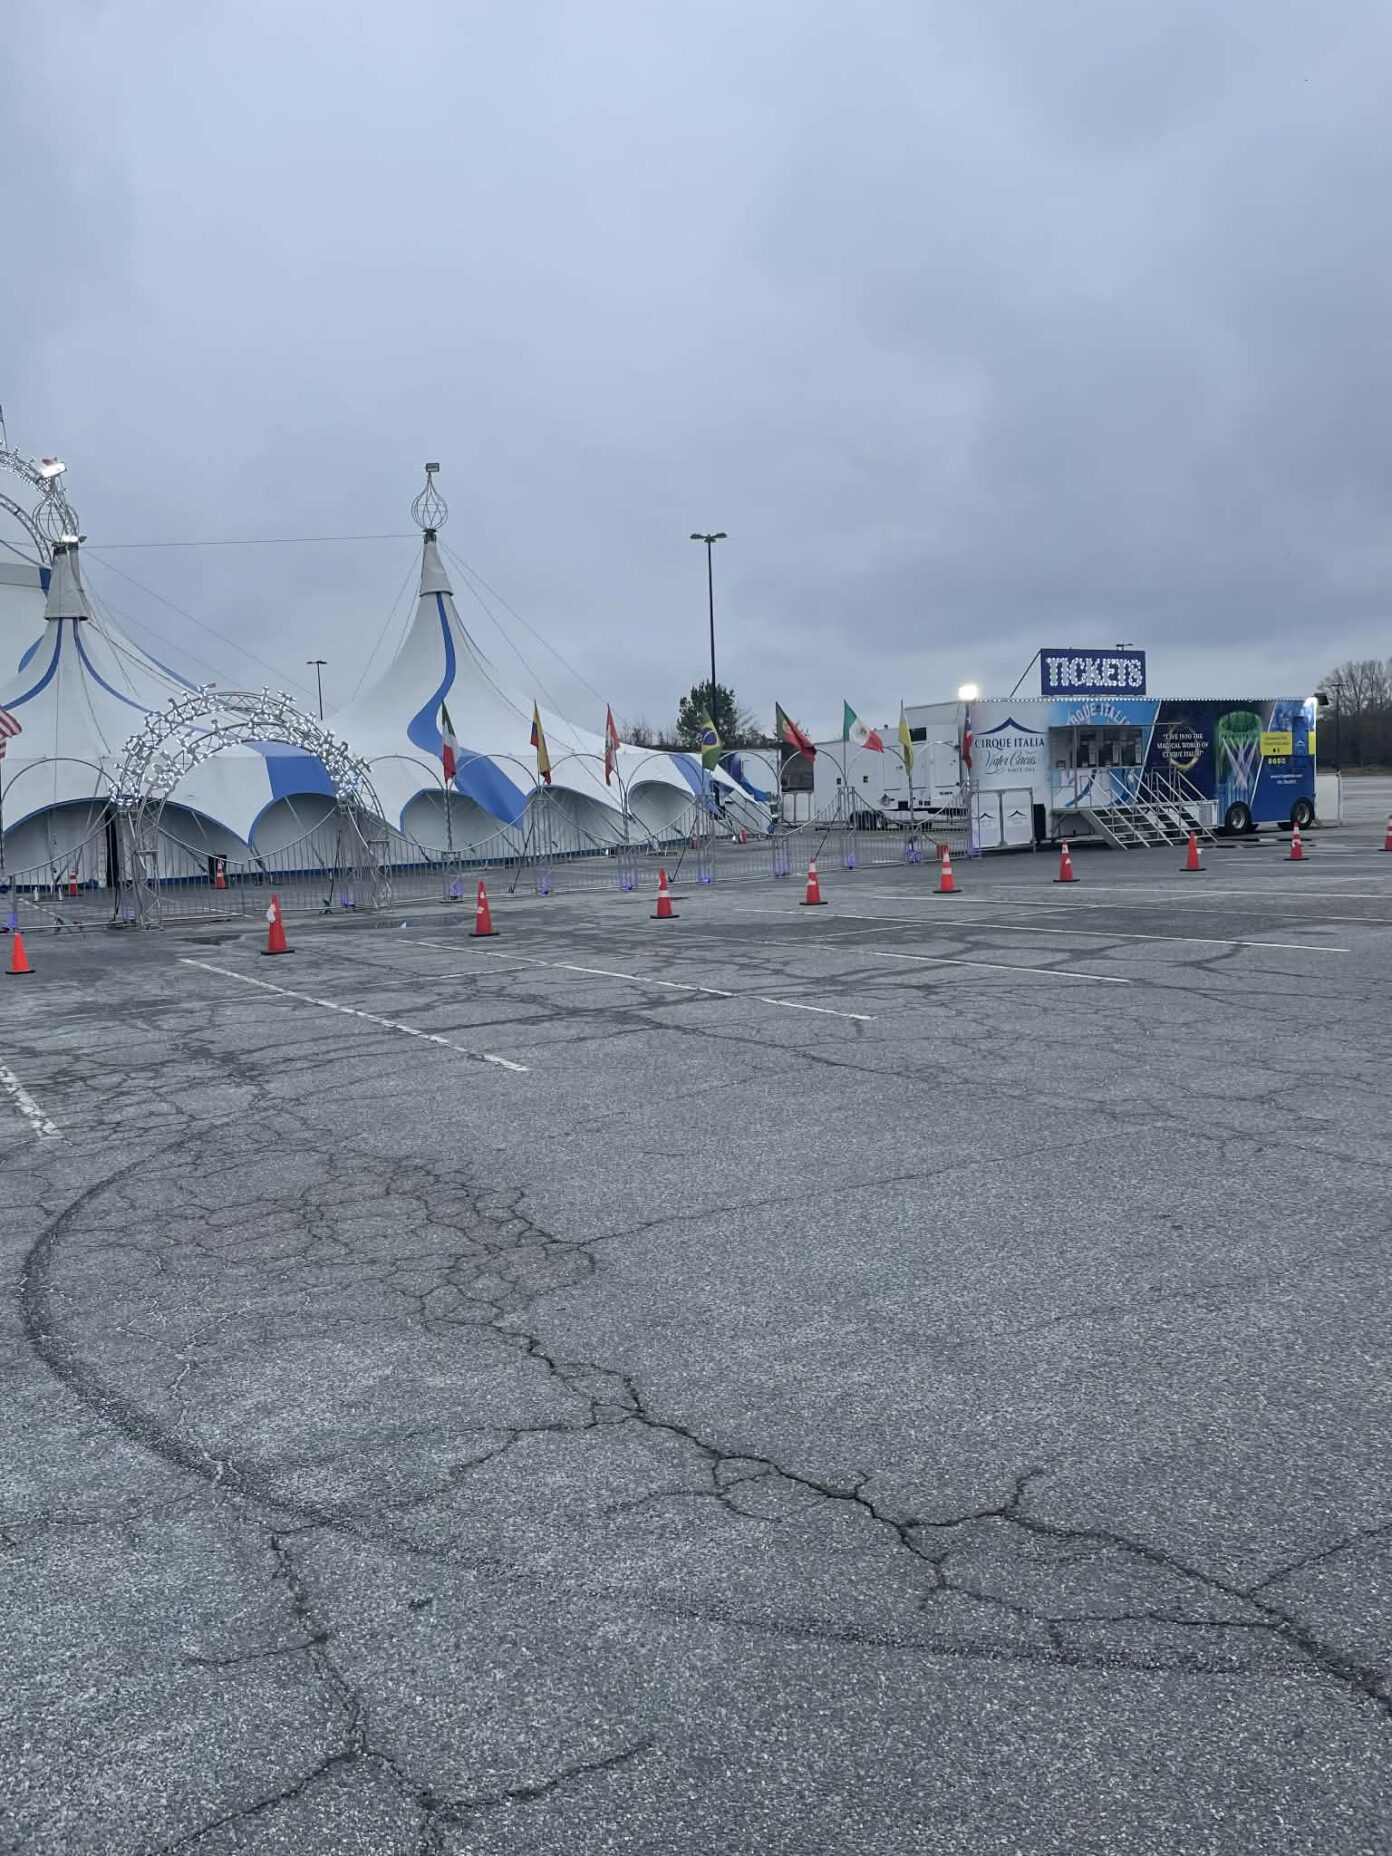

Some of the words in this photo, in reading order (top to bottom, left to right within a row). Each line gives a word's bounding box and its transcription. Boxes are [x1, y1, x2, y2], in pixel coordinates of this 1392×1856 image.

[1045, 657, 1142, 687] TICKETS
[974, 738, 1012, 750] CIRQUE
[1014, 737, 1045, 748] ITALIA
